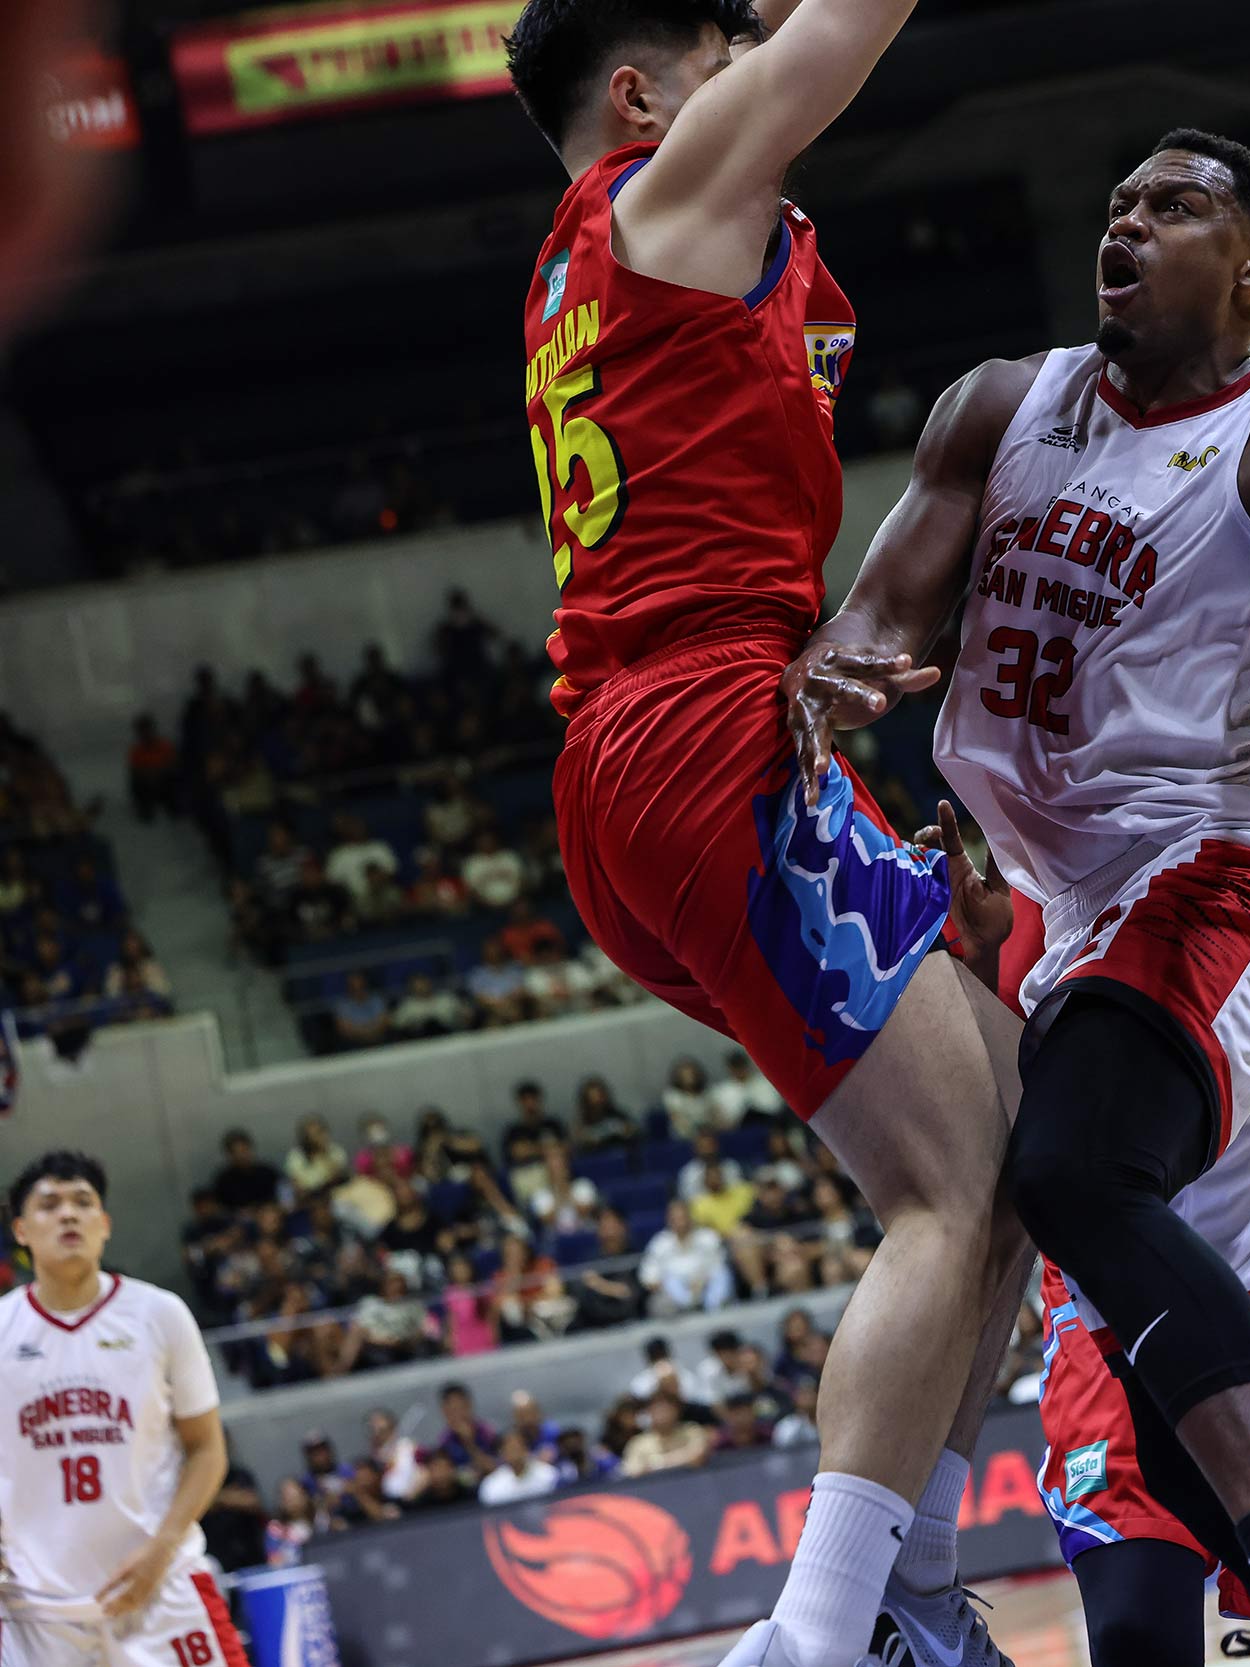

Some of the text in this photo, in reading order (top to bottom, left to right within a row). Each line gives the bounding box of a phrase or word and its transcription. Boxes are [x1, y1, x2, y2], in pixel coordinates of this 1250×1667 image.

[978, 564, 1130, 630] SAN MIGUE
[980, 626, 1078, 736] 32
[19, 1387, 134, 1437] GINEBRA
[31, 1430, 65, 1450] SAN
[60, 1454, 102, 1505] 18
[1070, 1458, 1098, 1478] Sista
[170, 1630, 213, 1667] 18
